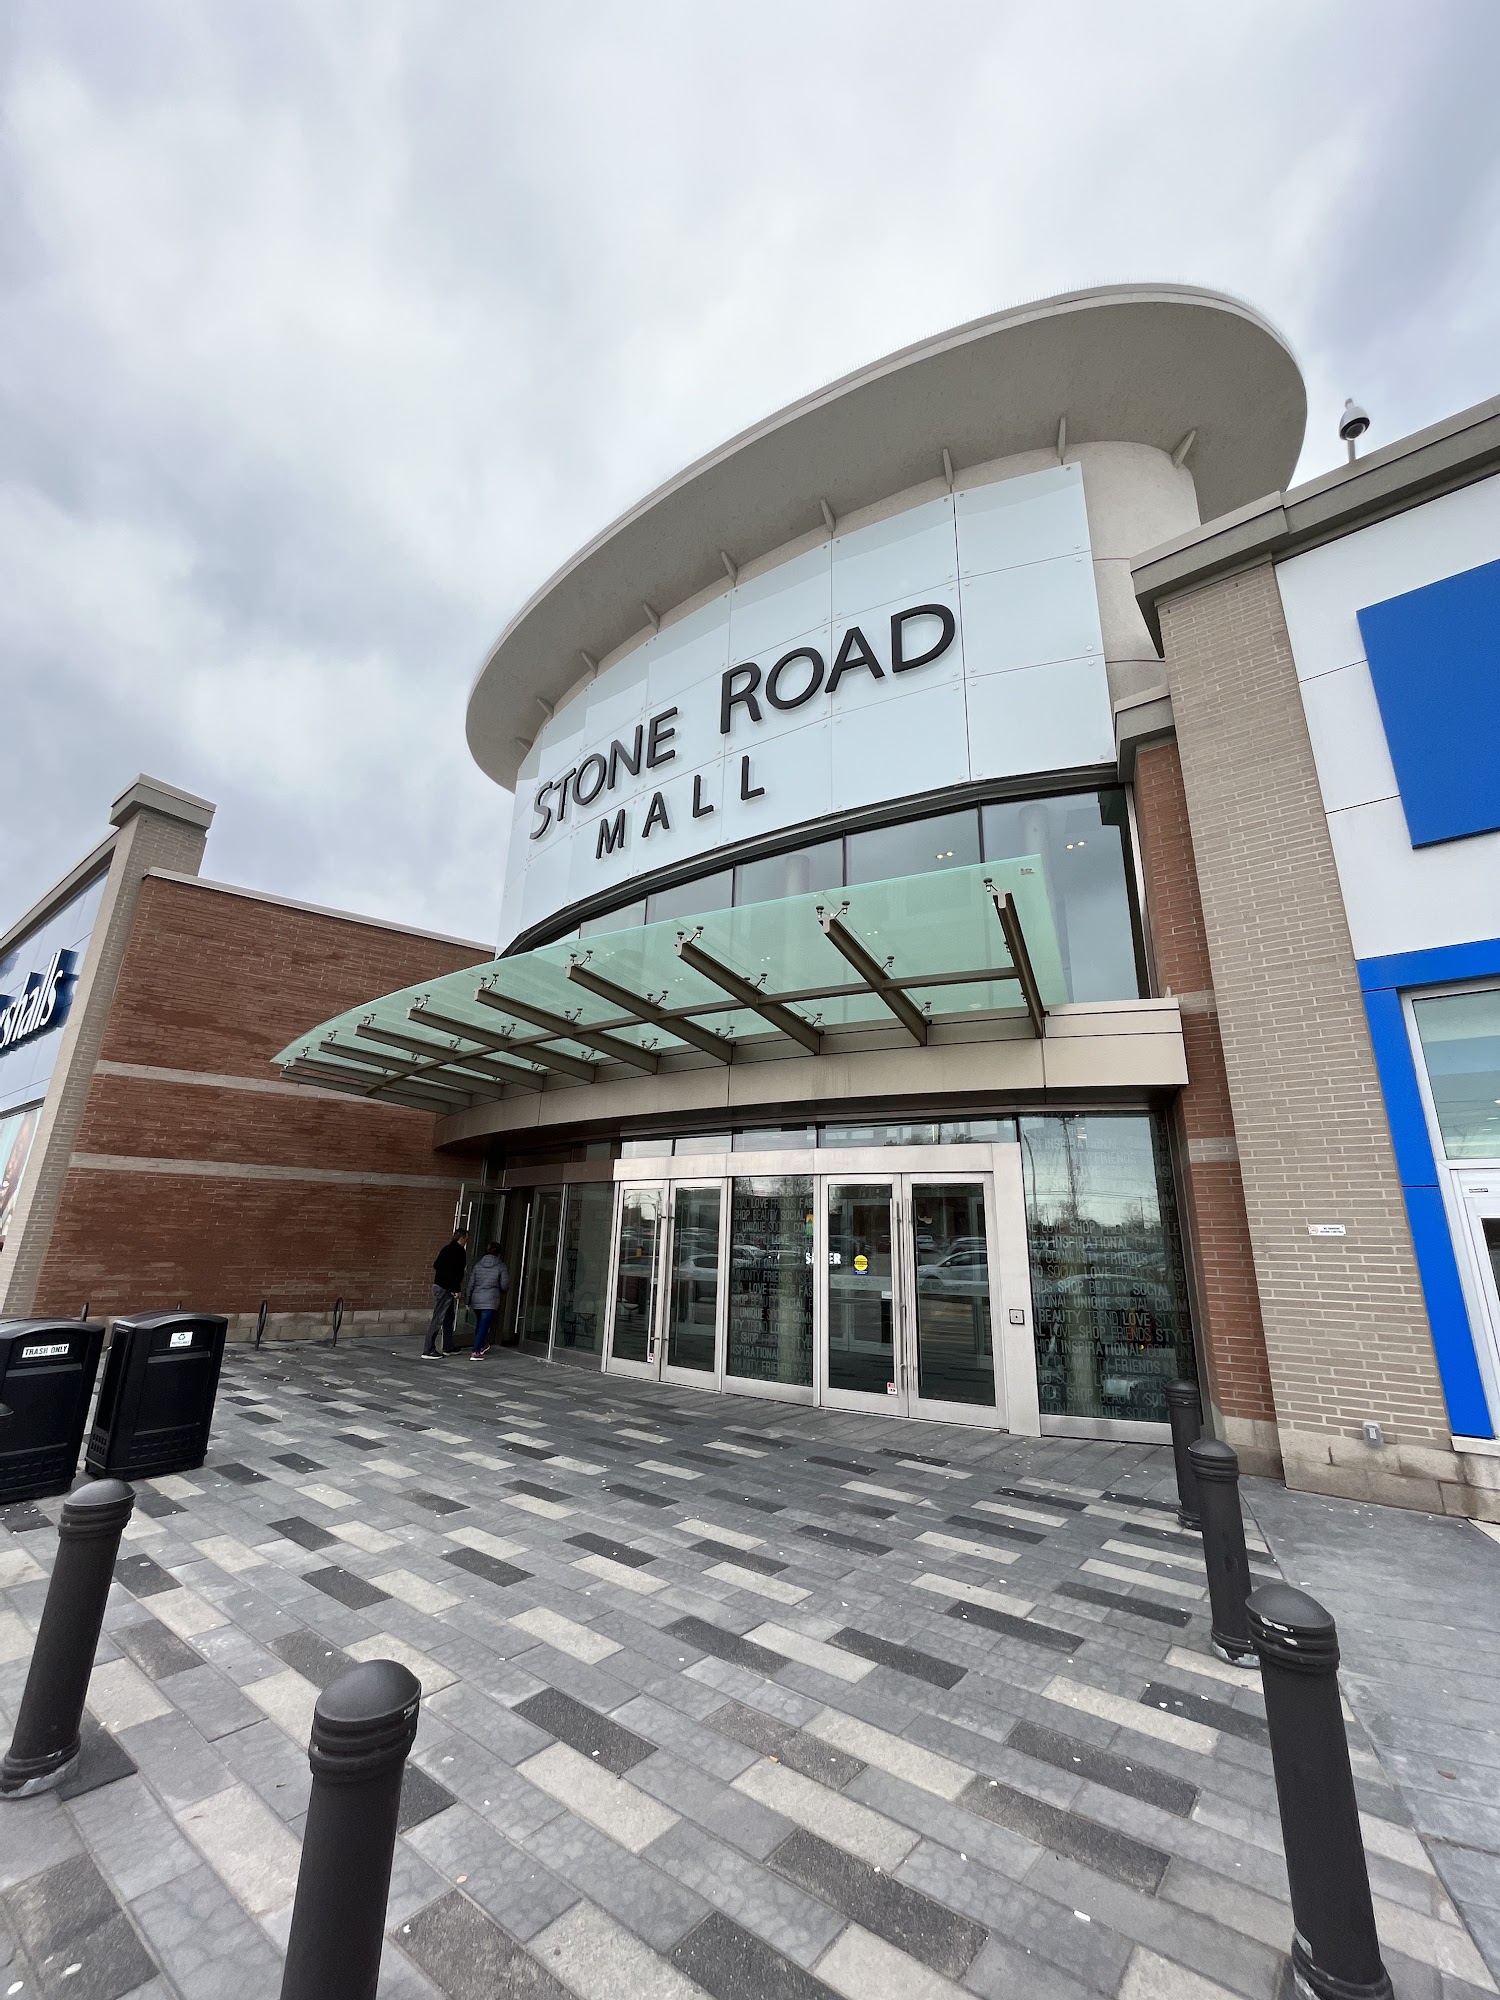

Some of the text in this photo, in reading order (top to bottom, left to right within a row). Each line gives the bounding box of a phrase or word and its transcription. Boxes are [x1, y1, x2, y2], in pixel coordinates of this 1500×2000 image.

[530, 603, 956, 840] STONE ROAD
[596, 755, 765, 859] MALL
[751, 1198, 768, 1208] LOVE
[734, 1210, 750, 1220] SHOP
[781, 1210, 805, 1220] SOCIAL
[1070, 1221, 1095, 1234] SHOP
[1052, 1236, 1131, 1250] INSPIRATIONAL
[1104, 1252, 1148, 1265] FRIENDS
[763, 1270, 792, 1282] FRIENDS
[1047, 1265, 1080, 1278] SOCIAL
[1084, 1266, 1111, 1279] LOVE
[749, 1282, 767, 1294] LOVE
[1057, 1280, 1084, 1293] SHOP
[1089, 1281, 1128, 1295] BEAUTY
[1132, 1282, 1172, 1296] SOCIAL
[779, 1296, 805, 1309] SOCIAL
[1073, 1295, 1112, 1310] UNIQUE
[1114, 1297, 1149, 1311] SOCIAL
[1039, 1309, 1188, 1328] BEAUTY TREND LOVE STYLE
[741, 1332, 759, 1344] SHOP
[1079, 1325, 1106, 1339] SHOP
[1111, 1327, 1152, 1341] FRIENDS
[1155, 1328, 1192, 1343] STYLE
[25, 1345, 68, 1356] TRASH ONLY
[1060, 1340, 1143, 1357] INSPIRATIONAL
[1114, 1358, 1161, 1374] FRIENDS
[1066, 1386, 1093, 1402] SHOP
